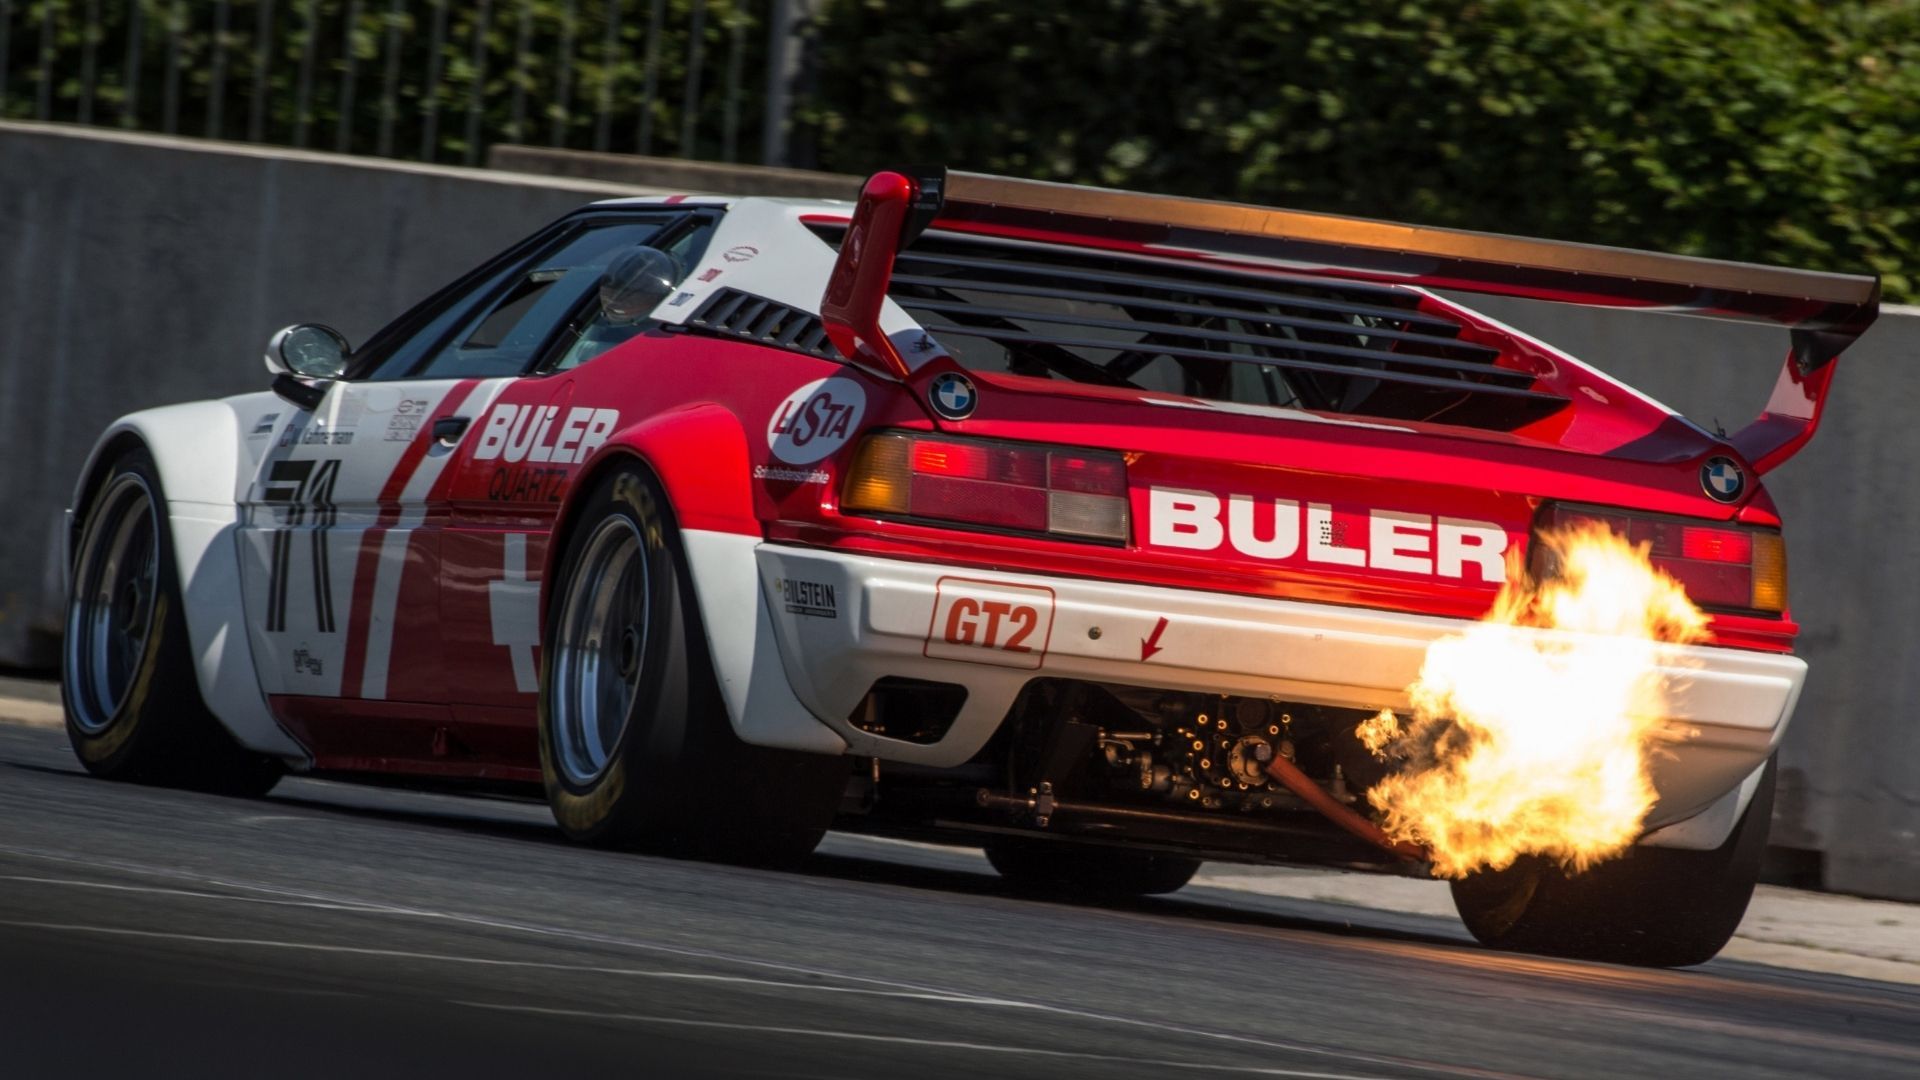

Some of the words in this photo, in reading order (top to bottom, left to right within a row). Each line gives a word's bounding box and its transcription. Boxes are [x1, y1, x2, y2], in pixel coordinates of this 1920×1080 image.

[473, 404, 620, 464] BULER
[772, 392, 855, 447] LISTA
[489, 467, 568, 501] QUARTZ
[1150, 485, 1508, 583] BULER
[784, 579, 836, 608] BILSTEIN
[944, 597, 1038, 654] GT2
